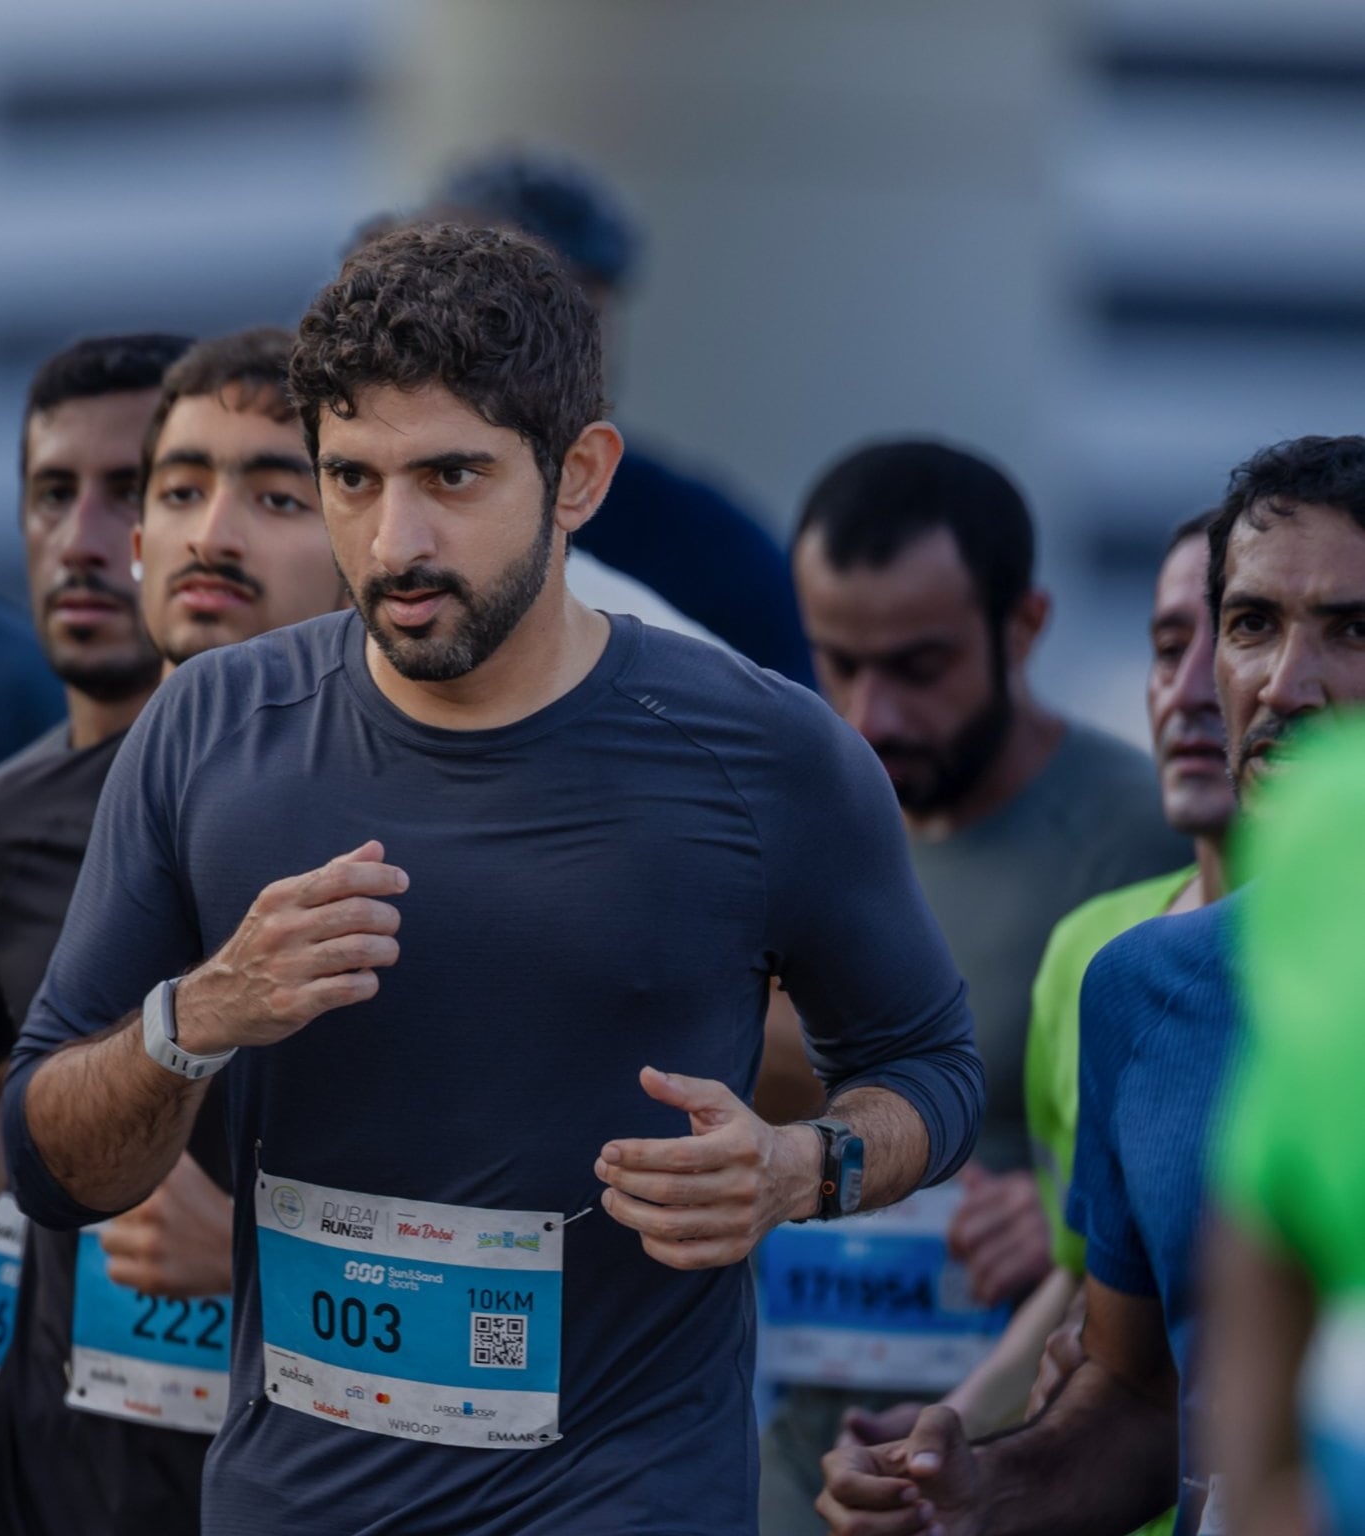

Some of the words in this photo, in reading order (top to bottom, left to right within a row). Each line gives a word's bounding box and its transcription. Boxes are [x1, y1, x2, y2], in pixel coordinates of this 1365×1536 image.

[322, 1201, 379, 1226] DUBAI
[320, 1219, 352, 1237] RUN
[351, 1230, 373, 1240] 2024
[397, 1223, 420, 1237] Mai
[421, 1223, 455, 1241] Dubai
[387, 1266, 444, 1285] Sun&Sand
[387, 1277, 420, 1292] Sports
[466, 1287, 534, 1312] 10KM
[133, 1292, 226, 1350] 222
[312, 1290, 402, 1353] 003
[280, 1366, 315, 1387] dubizzle
[345, 1385, 365, 1400] citi
[313, 1400, 350, 1420] talabat
[387, 1418, 441, 1436] WHOOP
[487, 1431, 535, 1442] EMAAR
